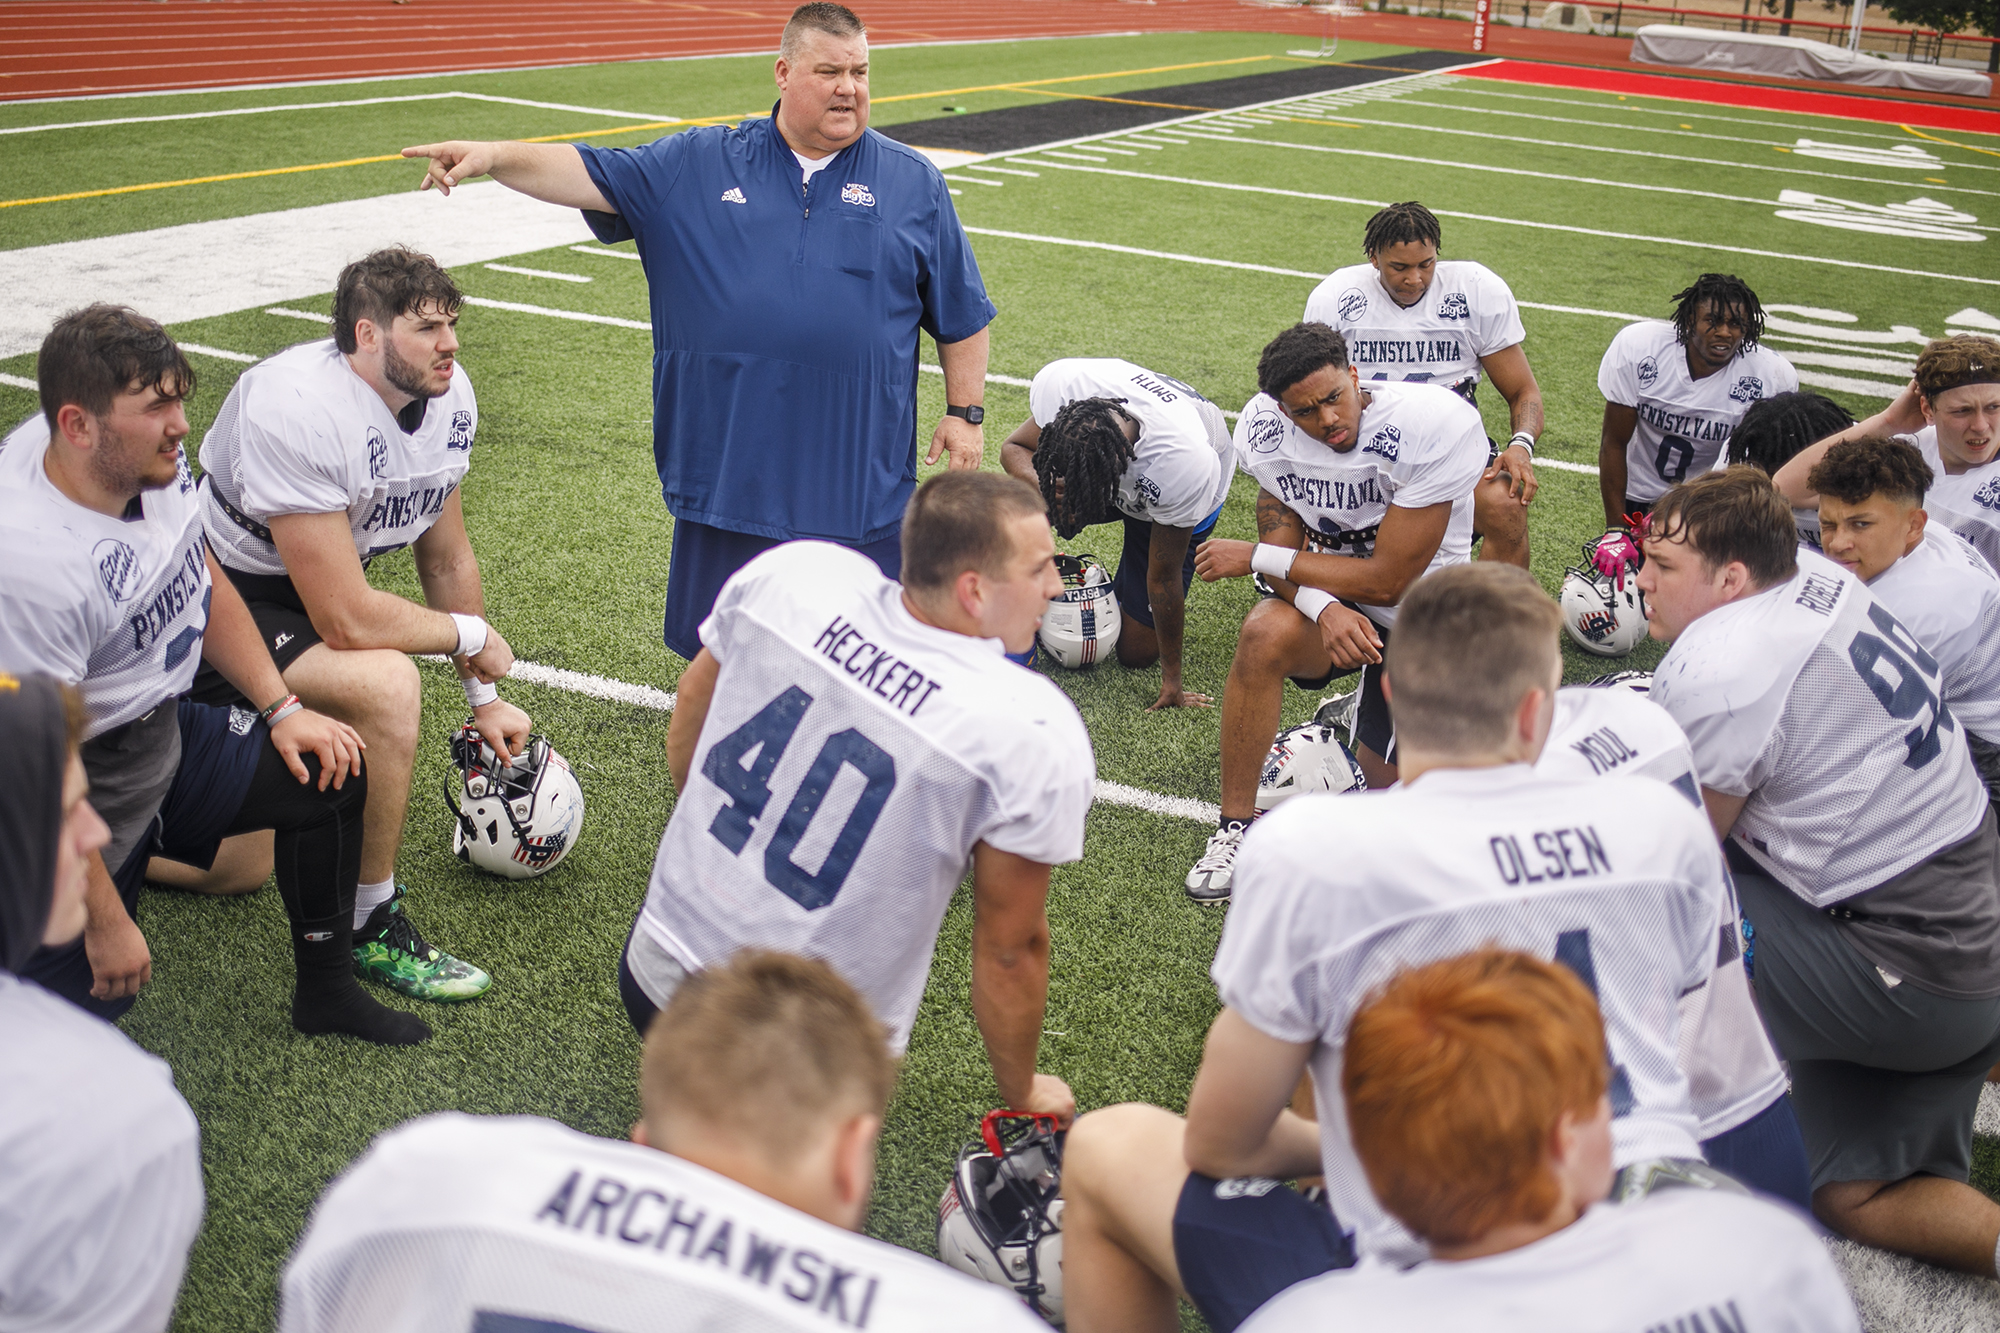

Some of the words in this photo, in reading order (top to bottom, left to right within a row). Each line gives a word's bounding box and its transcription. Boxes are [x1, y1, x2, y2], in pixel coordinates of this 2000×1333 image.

[1352, 340, 1461, 363] PENNSYLVANIA
[1130, 373, 1178, 403] SMITH
[1655, 434, 1695, 483] 0
[1065, 587, 1100, 602] PSFCA
[1794, 571, 1845, 617] ROBELL
[813, 615, 942, 717] HECKERT
[1569, 726, 1639, 776] MOUL
[701, 684, 896, 912] 40
[1489, 825, 1612, 886] OLSEN
[534, 1169, 880, 1331] ARCHAWSKI
